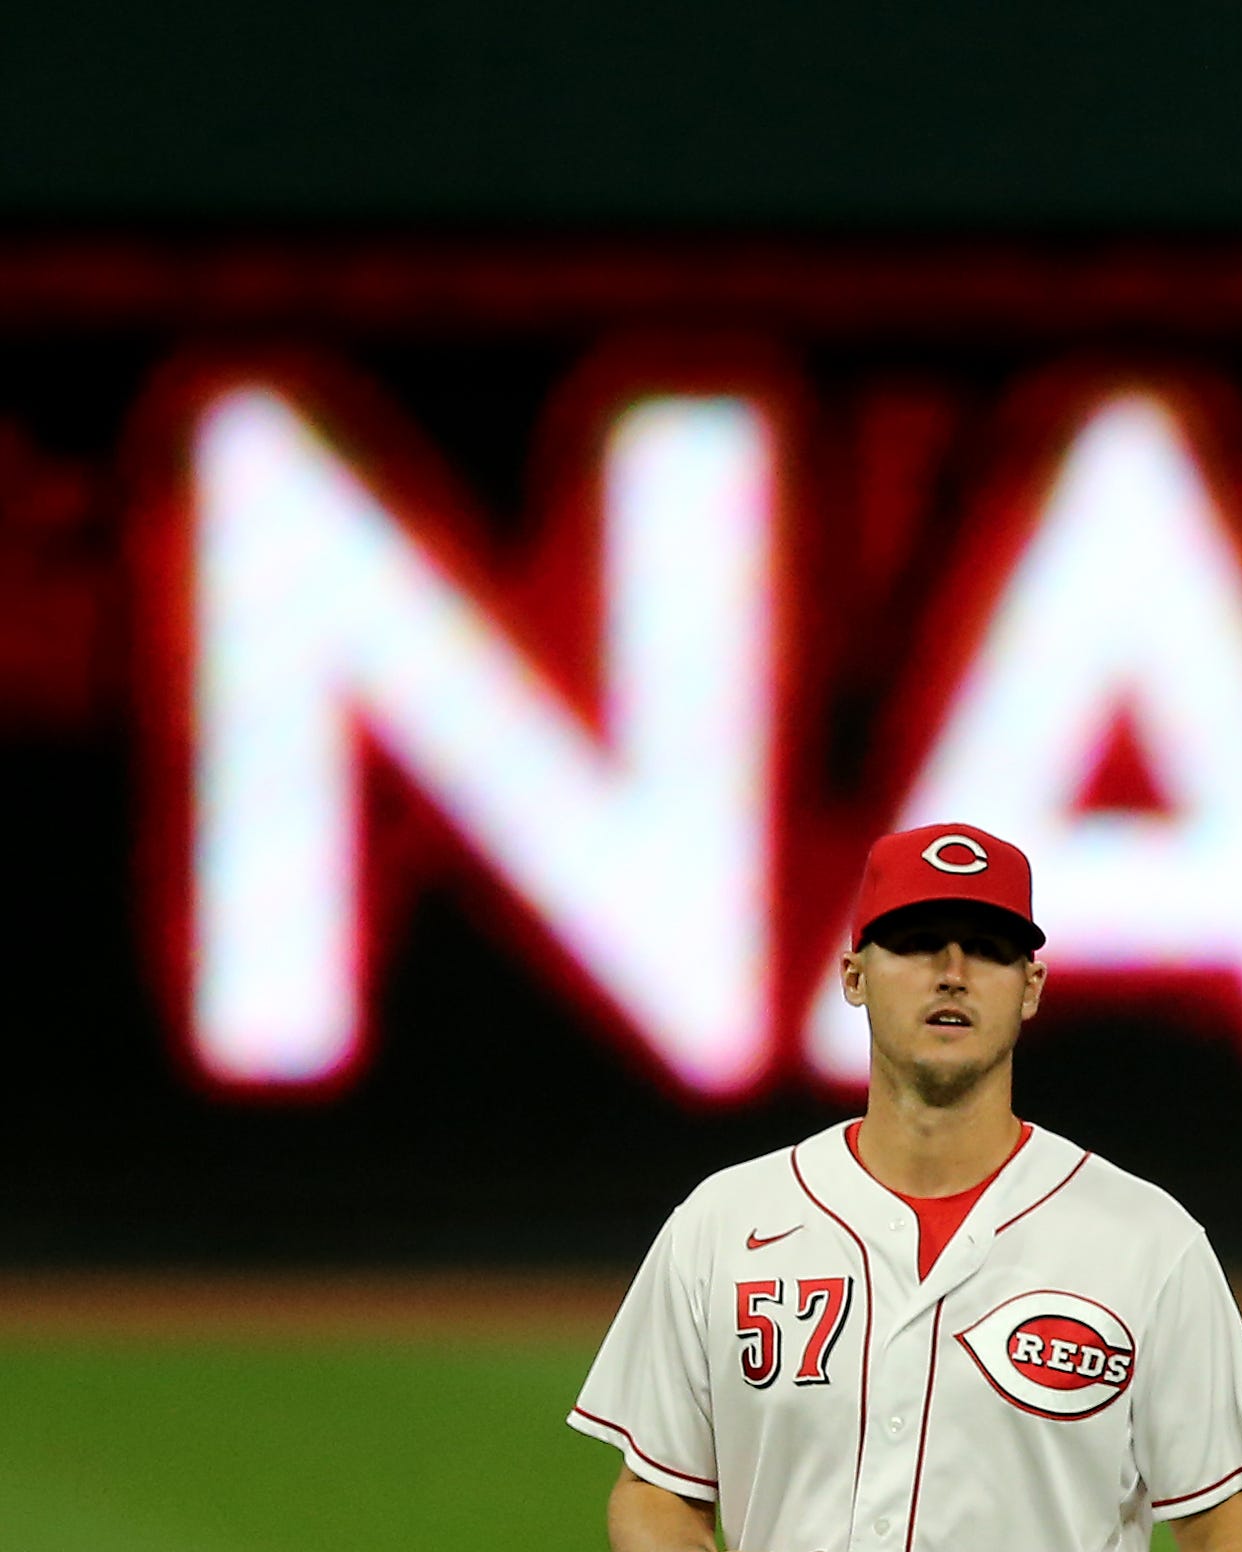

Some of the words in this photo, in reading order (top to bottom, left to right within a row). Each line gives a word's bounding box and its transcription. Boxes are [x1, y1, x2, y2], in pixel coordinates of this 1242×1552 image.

[921, 833, 989, 876] C
[734, 1277, 854, 1389] 57
[1011, 1331, 1132, 1385] REDS
